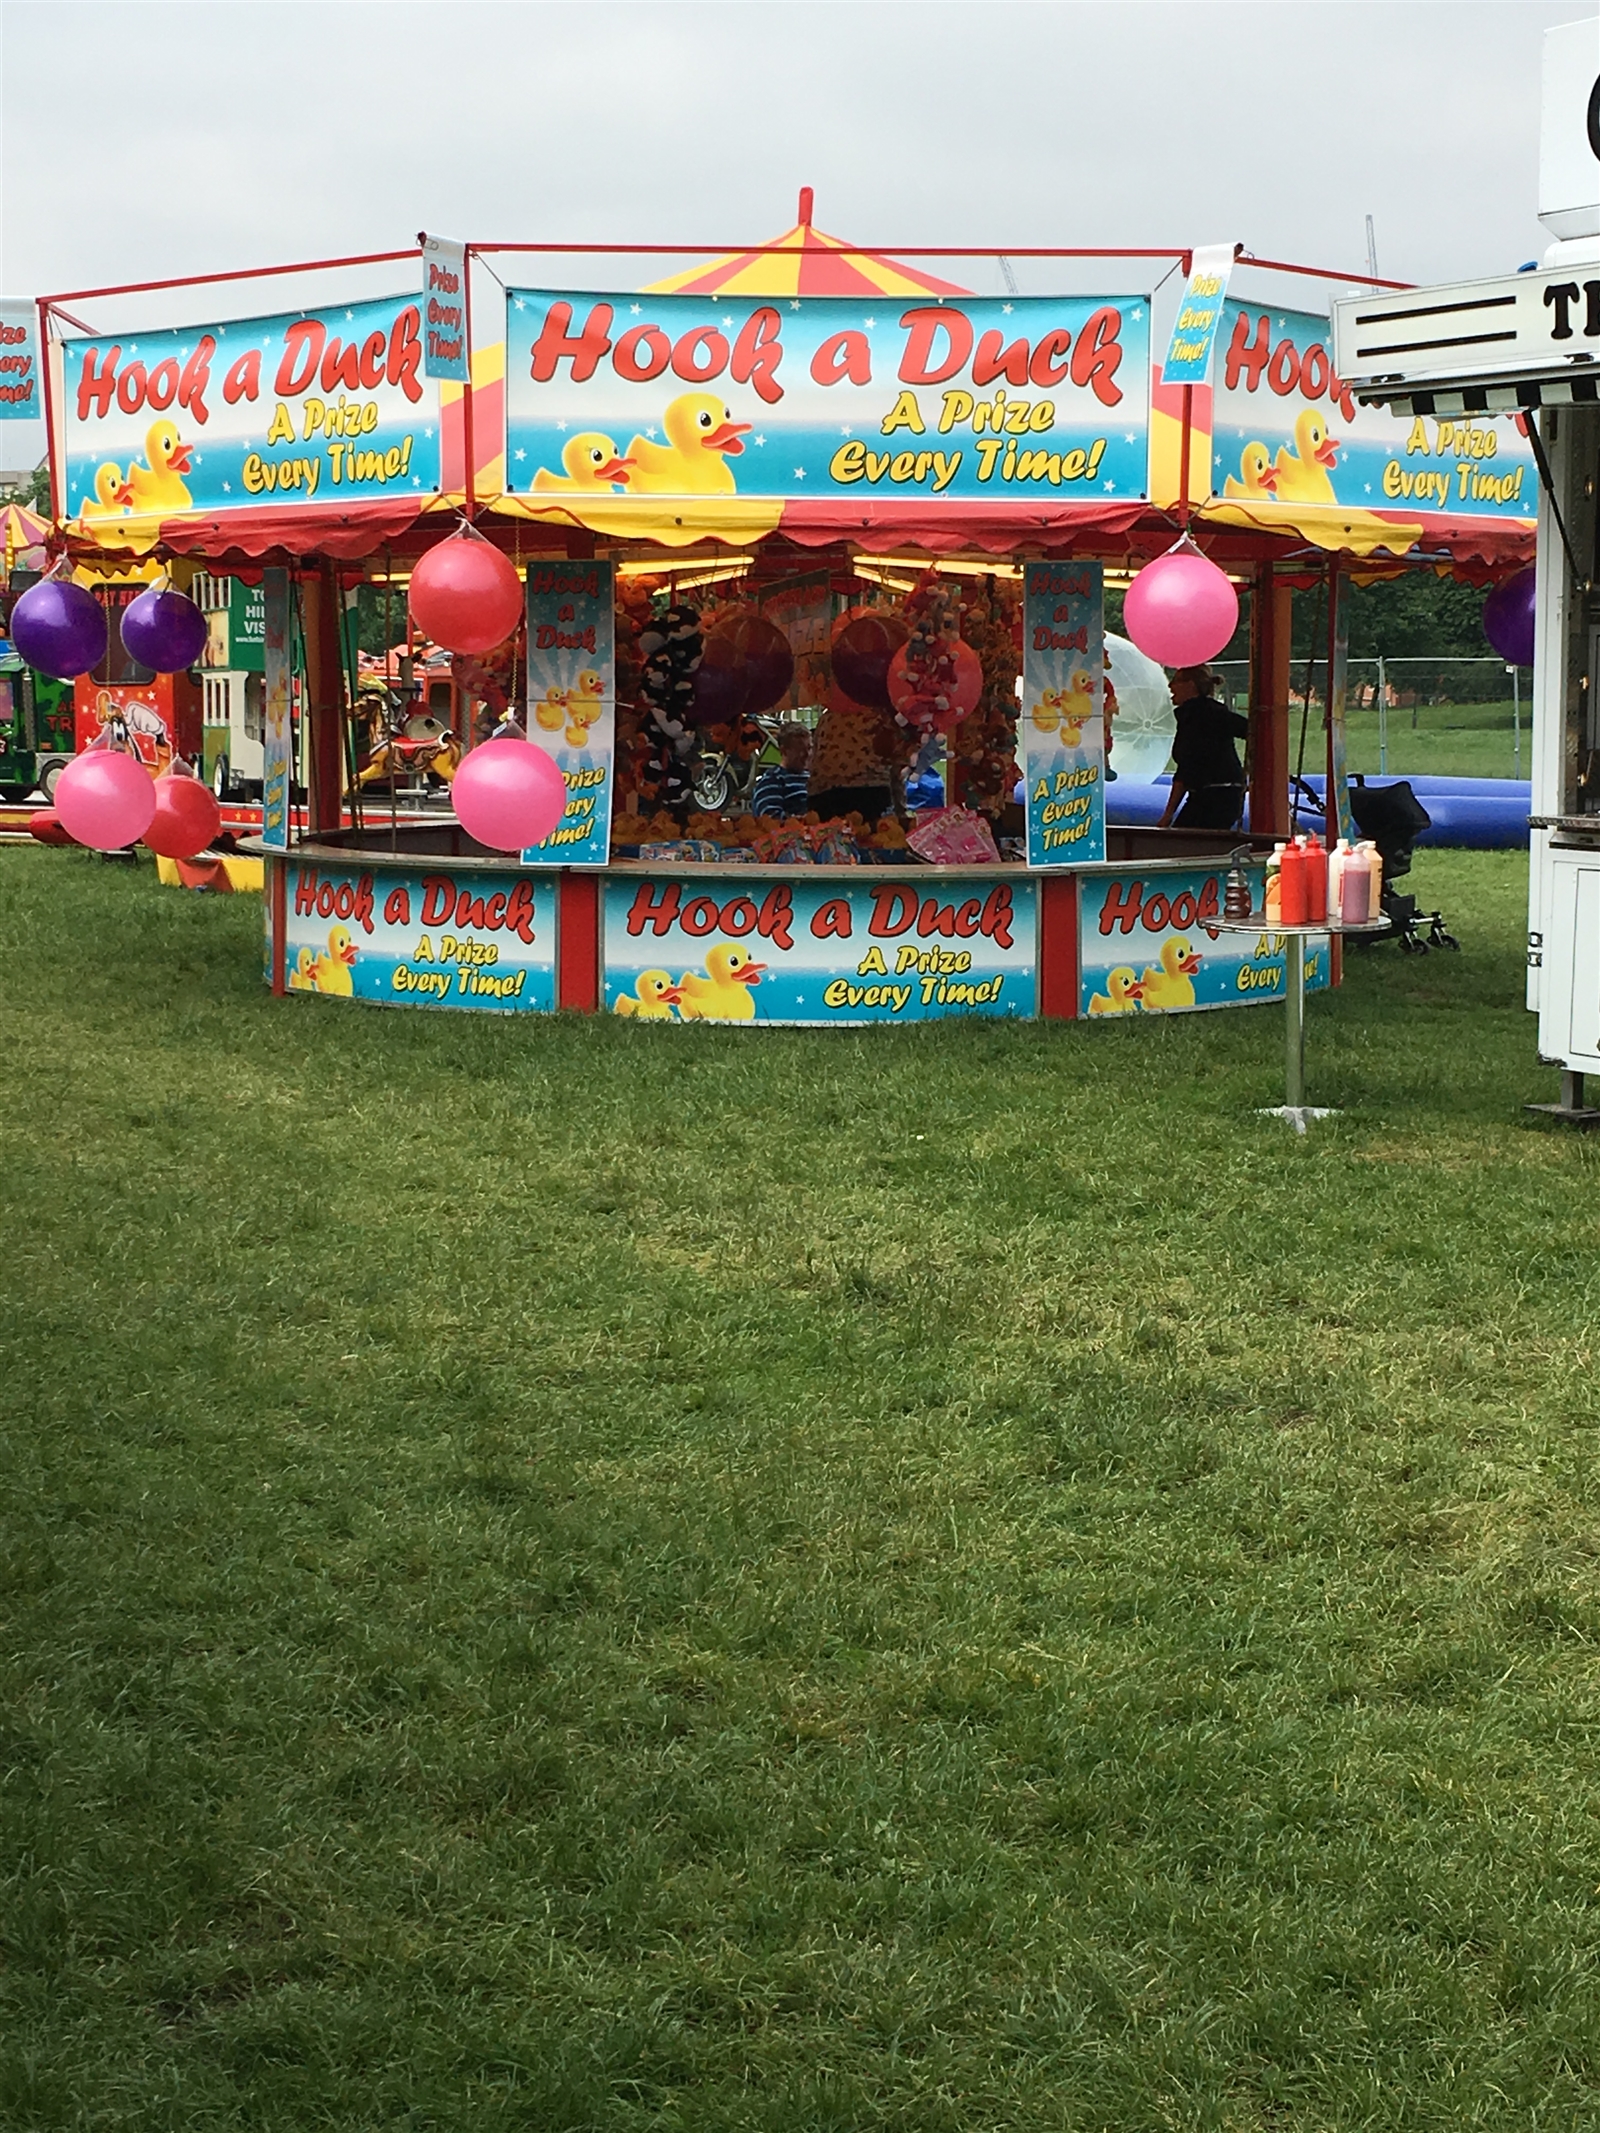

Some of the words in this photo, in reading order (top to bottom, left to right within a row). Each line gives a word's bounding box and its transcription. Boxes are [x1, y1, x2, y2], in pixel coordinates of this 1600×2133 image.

[429, 263, 459, 294] Prize
[1189, 272, 1222, 299] Prize
[428, 297, 462, 333] Every
[1178, 307, 1215, 334] Every
[77, 335, 216, 425] Hook
[223, 350, 262, 404] a
[274, 304, 424, 403] Duck
[531, 301, 784, 404] Hook
[810, 330, 872, 386] a
[898, 306, 1123, 407] Duck
[1170, 336, 1210, 364] Time!
[268, 403, 294, 446] A
[303, 395, 378, 441] Prize
[881, 390, 925, 435] A
[938, 389, 1055, 434] Prize
[1406, 413, 1430, 457] A
[1436, 418, 1497, 460] Prize
[242, 453, 320, 496] Every
[327, 436, 413, 485] Time!
[829, 440, 963, 493] Every
[975, 438, 1106, 486] Time!
[1382, 459, 1449, 508] Every
[1456, 462, 1524, 502] Time!
[532, 570, 600, 597] Hook
[1030, 571, 1091, 598] Hook
[557, 603, 575, 622] a
[1053, 604, 1069, 623] a
[535, 624, 597, 654] Duck
[1032, 625, 1089, 653] Duck
[1033, 778, 1049, 802] A
[1055, 765, 1098, 794] Prize
[1042, 794, 1091, 826] Every
[1042, 815, 1091, 850] Time!
[295, 868, 375, 934] Hook
[384, 887, 410, 925] a
[420, 874, 535, 944] Duck
[626, 881, 794, 950] Hook
[810, 898, 852, 938] a
[867, 883, 1014, 949] Duck
[1099, 877, 1220, 940] Hook
[414, 935, 434, 963] A
[440, 935, 498, 965] Prize
[857, 946, 886, 977] A
[896, 944, 971, 974] Prize
[392, 966, 451, 999] Every
[457, 967, 526, 997] Time!
[823, 980, 910, 1012] Every
[921, 975, 1004, 1006] Time!
[1237, 963, 1282, 992] Every
